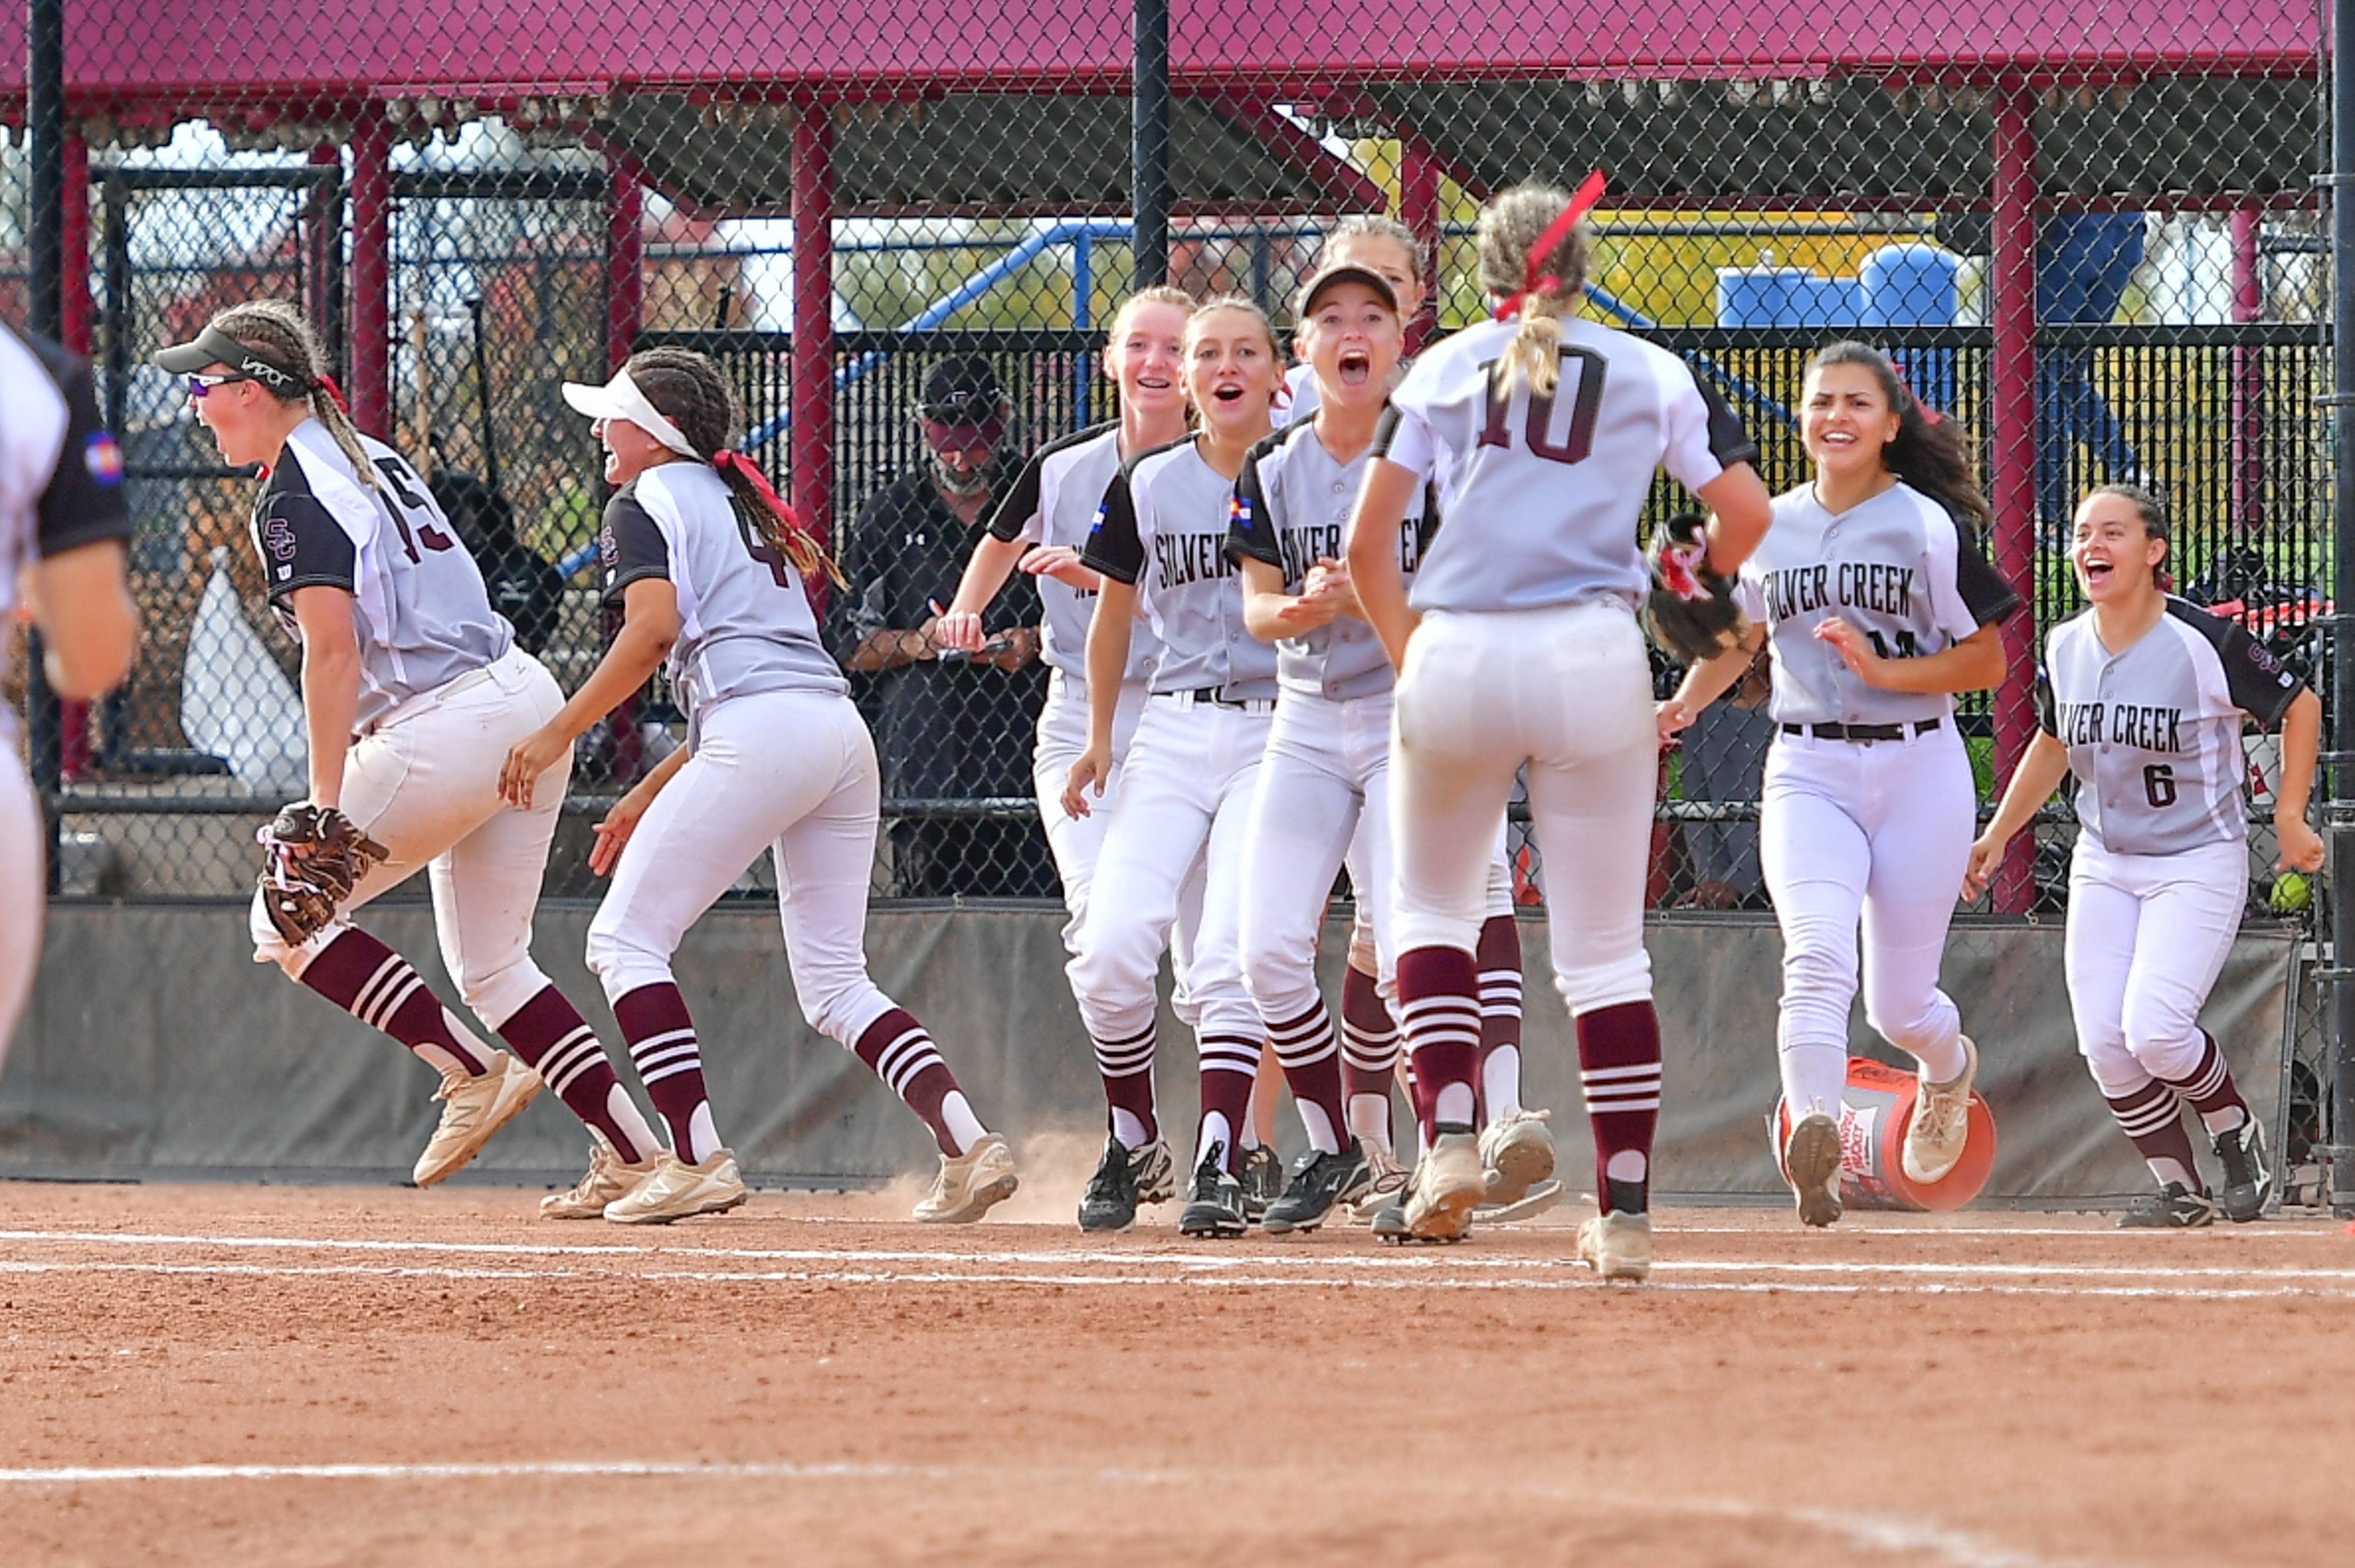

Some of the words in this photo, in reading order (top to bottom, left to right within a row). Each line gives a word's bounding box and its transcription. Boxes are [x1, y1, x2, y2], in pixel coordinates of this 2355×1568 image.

[1476, 344, 1610, 465] 10
[372, 457, 455, 565] 15
[726, 495, 790, 588] 4
[1762, 563, 1830, 625] SILVER
[1837, 562, 1913, 618] CREEK
[2113, 704, 2181, 753] CREEK
[2143, 764, 2177, 808] 6
